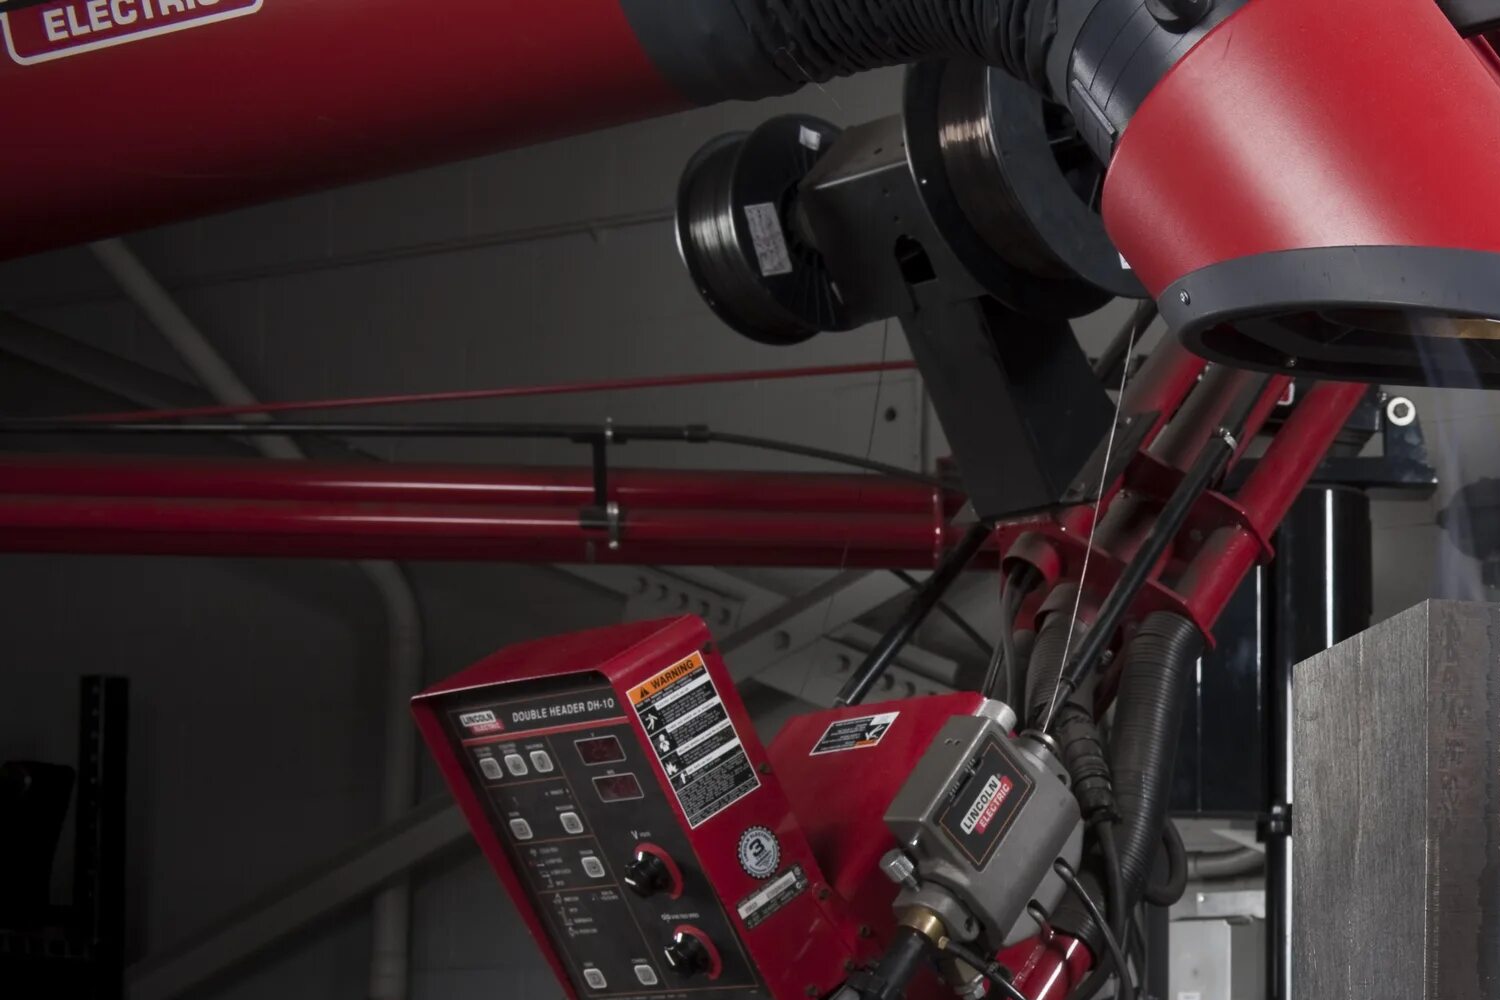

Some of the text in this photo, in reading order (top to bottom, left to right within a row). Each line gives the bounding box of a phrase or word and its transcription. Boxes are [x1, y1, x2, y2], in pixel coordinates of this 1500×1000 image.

[651, 660, 695, 689] WARNING
[512, 698, 615, 723] DOUBLE HEADER DH-10
[963, 780, 998, 830] LINCOLN
[979, 783, 1010, 828] ELECTRIC
[749, 838, 765, 858] 3
